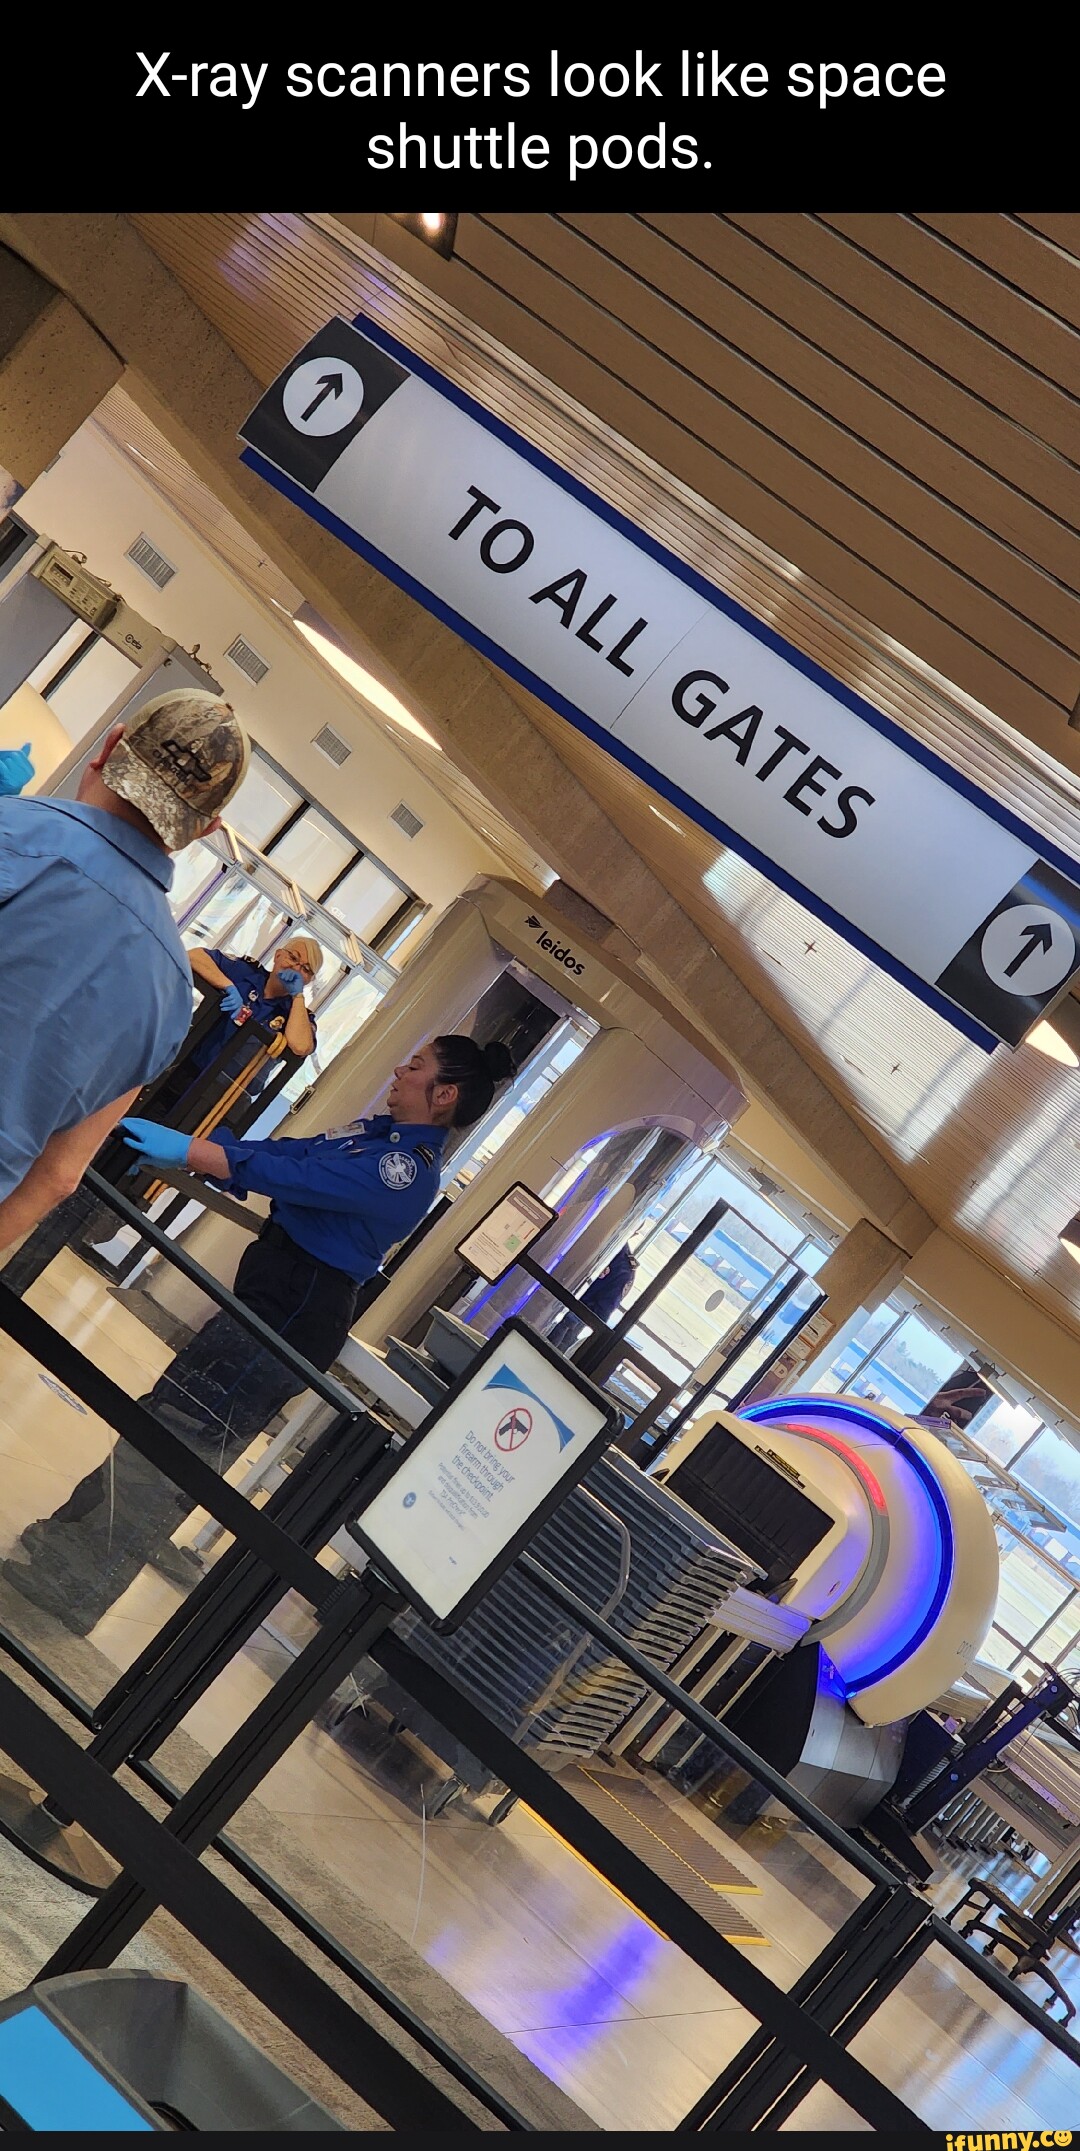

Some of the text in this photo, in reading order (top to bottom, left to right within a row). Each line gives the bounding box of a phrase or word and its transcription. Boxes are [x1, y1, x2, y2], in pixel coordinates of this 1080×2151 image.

[448, 485, 876, 839] TO ALL GATES
[535, 930, 586, 976] leidos
[450, 1453, 496, 1504] the checkpoint.
[458, 1441, 506, 1494] firearm through
[464, 1429, 516, 1486] Do not bring your
